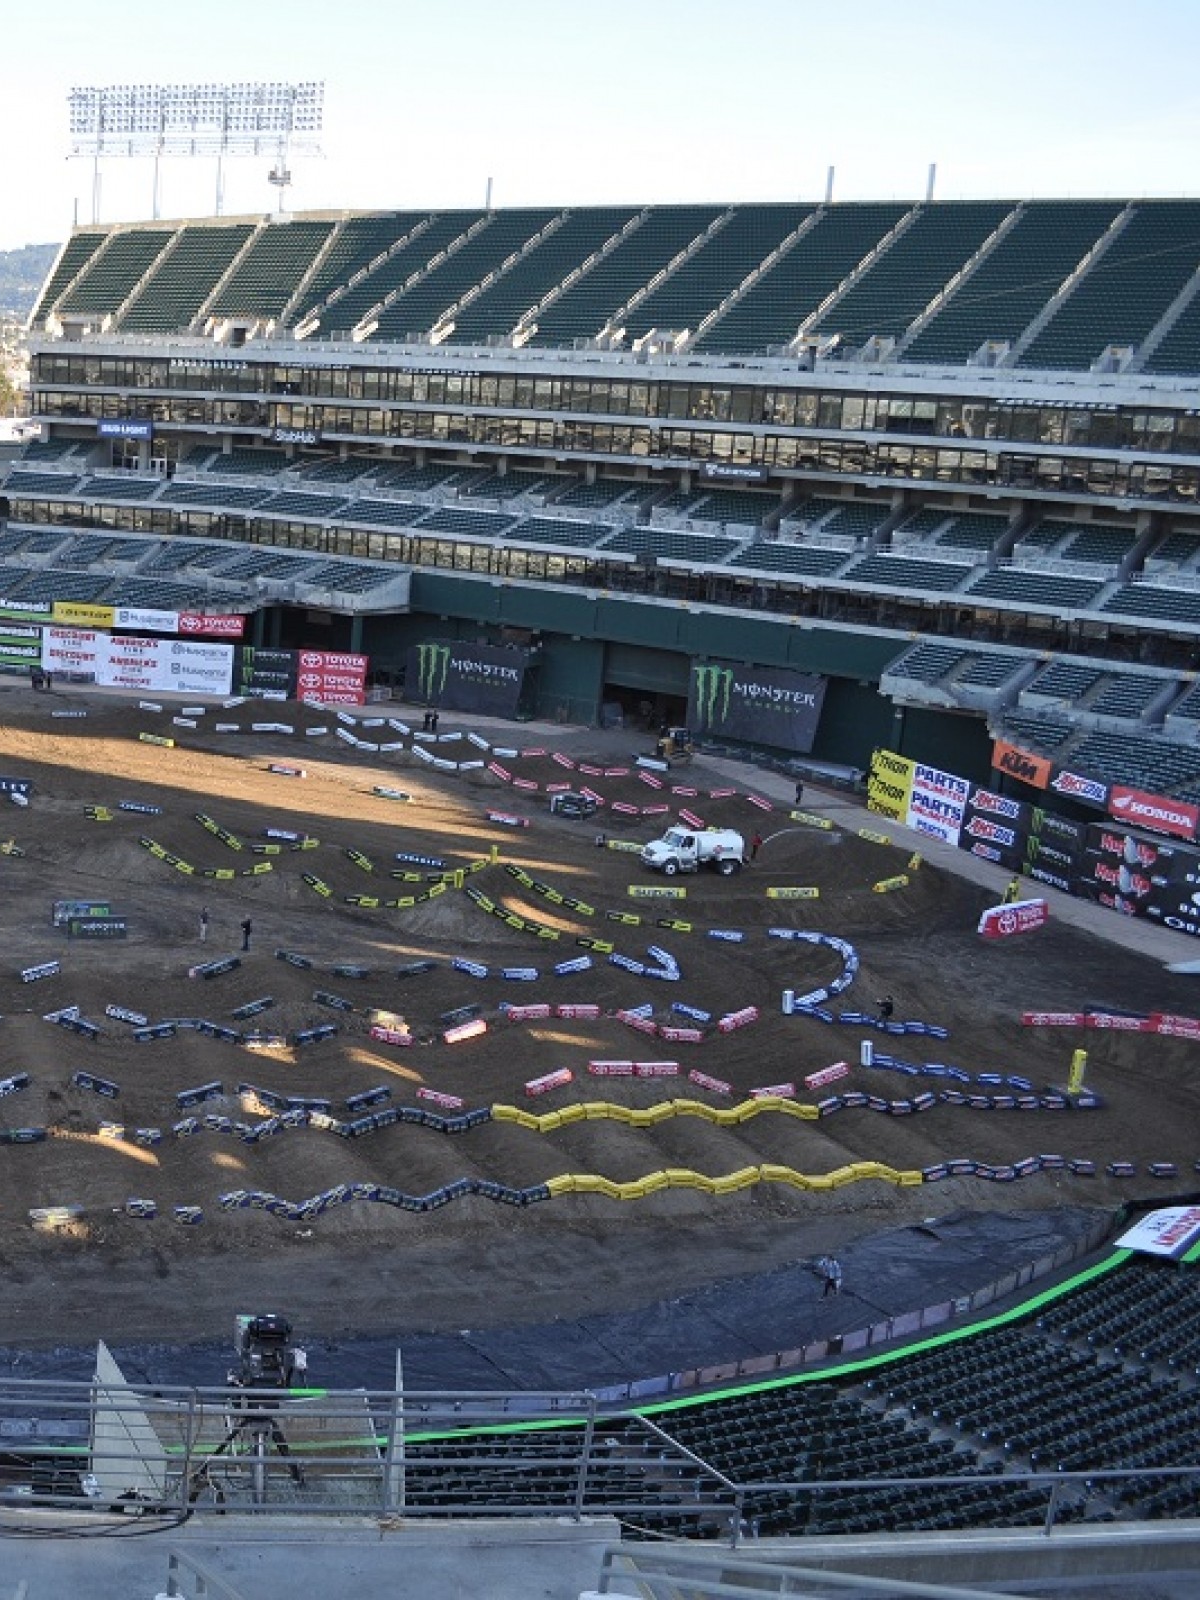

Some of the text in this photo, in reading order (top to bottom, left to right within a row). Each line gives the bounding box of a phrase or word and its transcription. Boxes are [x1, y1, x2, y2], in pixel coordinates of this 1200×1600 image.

[275, 429, 315, 444] StubHub
[65, 609, 111, 618] DUNLOP
[131, 614, 174, 625] Husqvarna
[203, 617, 242, 628] TOYOTA
[50, 630, 96, 641] DISCOUNT
[111, 637, 158, 648] AMERICA'S
[50, 649, 96, 661] DISCOUNT
[186, 647, 229, 657] Husqvarna
[109, 656, 158, 667] AMERICA'S
[325, 655, 364, 665] TOYOTA
[182, 667, 226, 677] Husqvarna
[450, 658, 518, 681] MONSTER
[323, 674, 361, 685] TOYOTA
[323, 692, 358, 702] TOYOTA
[733, 682, 815, 708] MONSTER
[881, 755, 909, 776] THOR
[1000, 751, 1038, 780] KTM
[915, 766, 966, 793] PARTS
[1059, 773, 1105, 801] AMSOIL
[877, 779, 905, 802] THOR
[874, 801, 900, 820] THOR
[912, 791, 961, 820] PARTS
[976, 791, 1018, 817] AMSOIL
[1130, 802, 1193, 828] HONDA
[917, 819, 948, 839] PARTS
[972, 819, 1014, 844] AMSOIL
[82, 922, 125, 930] MONSTER
